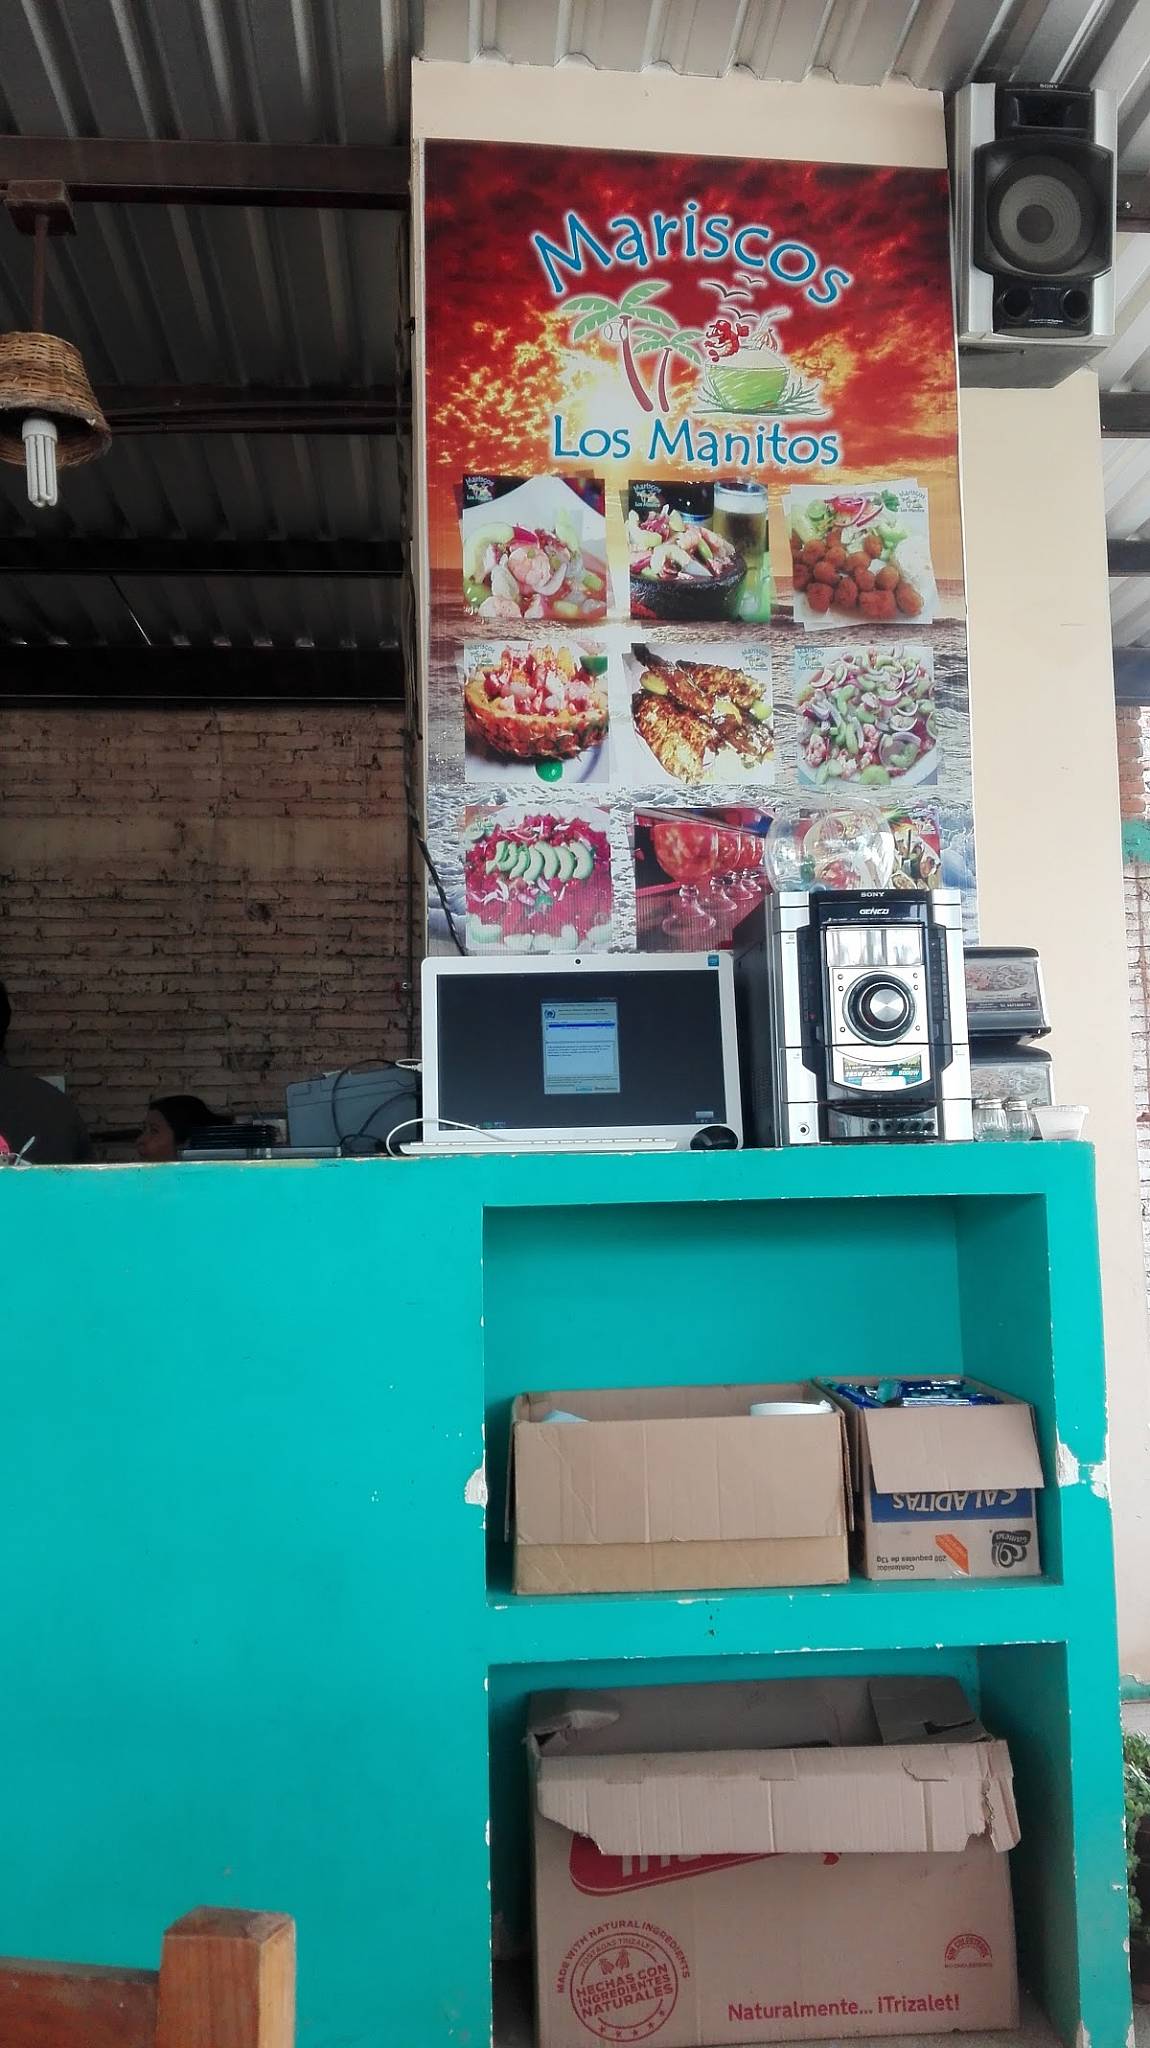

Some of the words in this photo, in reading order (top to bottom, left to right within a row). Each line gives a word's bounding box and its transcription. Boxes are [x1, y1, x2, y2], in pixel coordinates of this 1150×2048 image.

[533, 202, 851, 305] Mariscos
[553, 416, 630, 459] Los
[647, 419, 840, 466] Manitos
[893, 1488, 1018, 1512] SALADITAS
[901, 1554, 933, 1563] paquetes
[557, 1961, 570, 1993] MADE
[565, 1936, 588, 1960] WITH
[588, 1920, 640, 1938] NATURAL
[641, 1921, 690, 1979] INGREDIENTS
[576, 1973, 635, 1998] HECHAS
[638, 1963, 668, 1981] CON
[578, 1974, 671, 2007] INGREDIENTES
[581, 1983, 674, 2018] NATURALES
[728, 2000, 873, 2021] Naturalmente...
